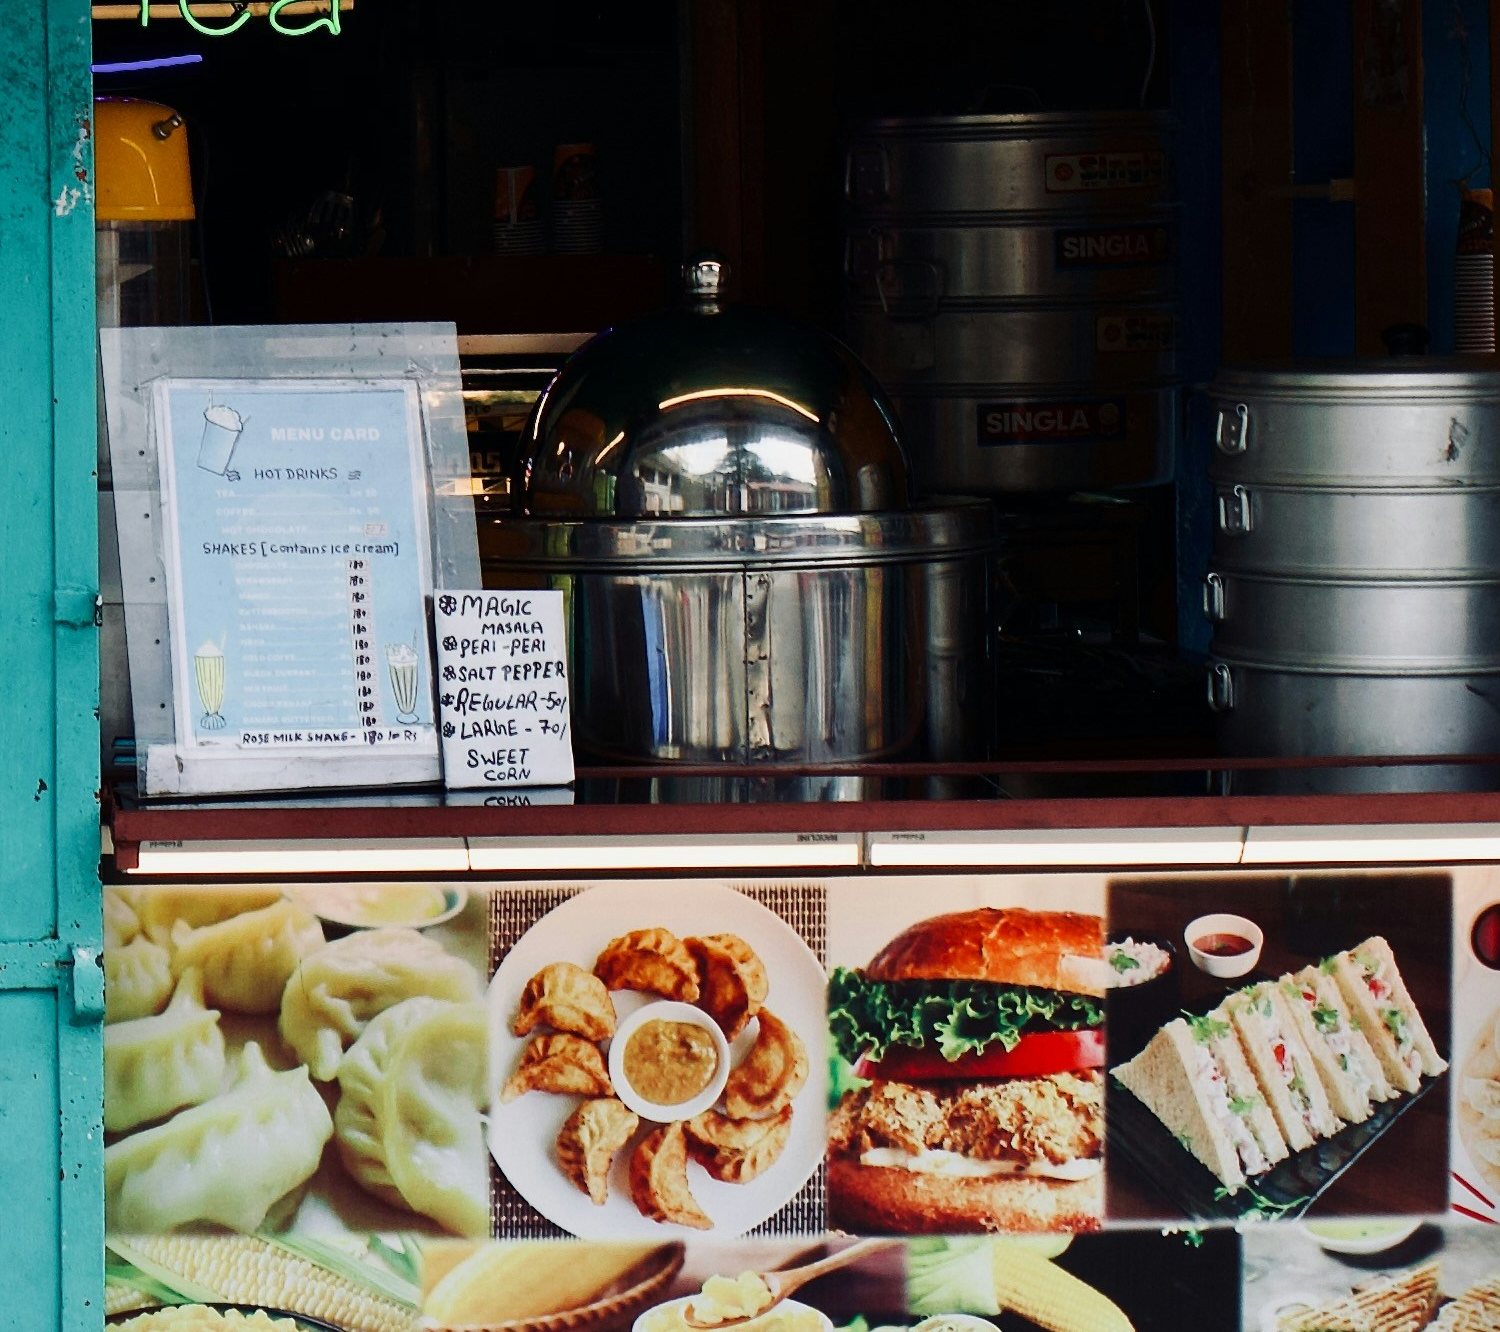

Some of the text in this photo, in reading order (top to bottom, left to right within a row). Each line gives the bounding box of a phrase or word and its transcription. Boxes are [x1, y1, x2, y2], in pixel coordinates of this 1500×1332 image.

[1062, 234, 1149, 260] SINGLA
[985, 408, 1090, 435] SINGLA
[270, 426, 380, 442] MENU CARD
[253, 467, 339, 481] HOT DRINKS
[202, 542, 257, 556] SHAKES
[460, 594, 533, 618] MAGIC
[481, 621, 544, 636] MASALA
[458, 660, 566, 682] SALT PEPPER
[273, 731, 302, 743] MILK
[460, 719, 519, 740] LARGE
[466, 748, 530, 768] SWEET
